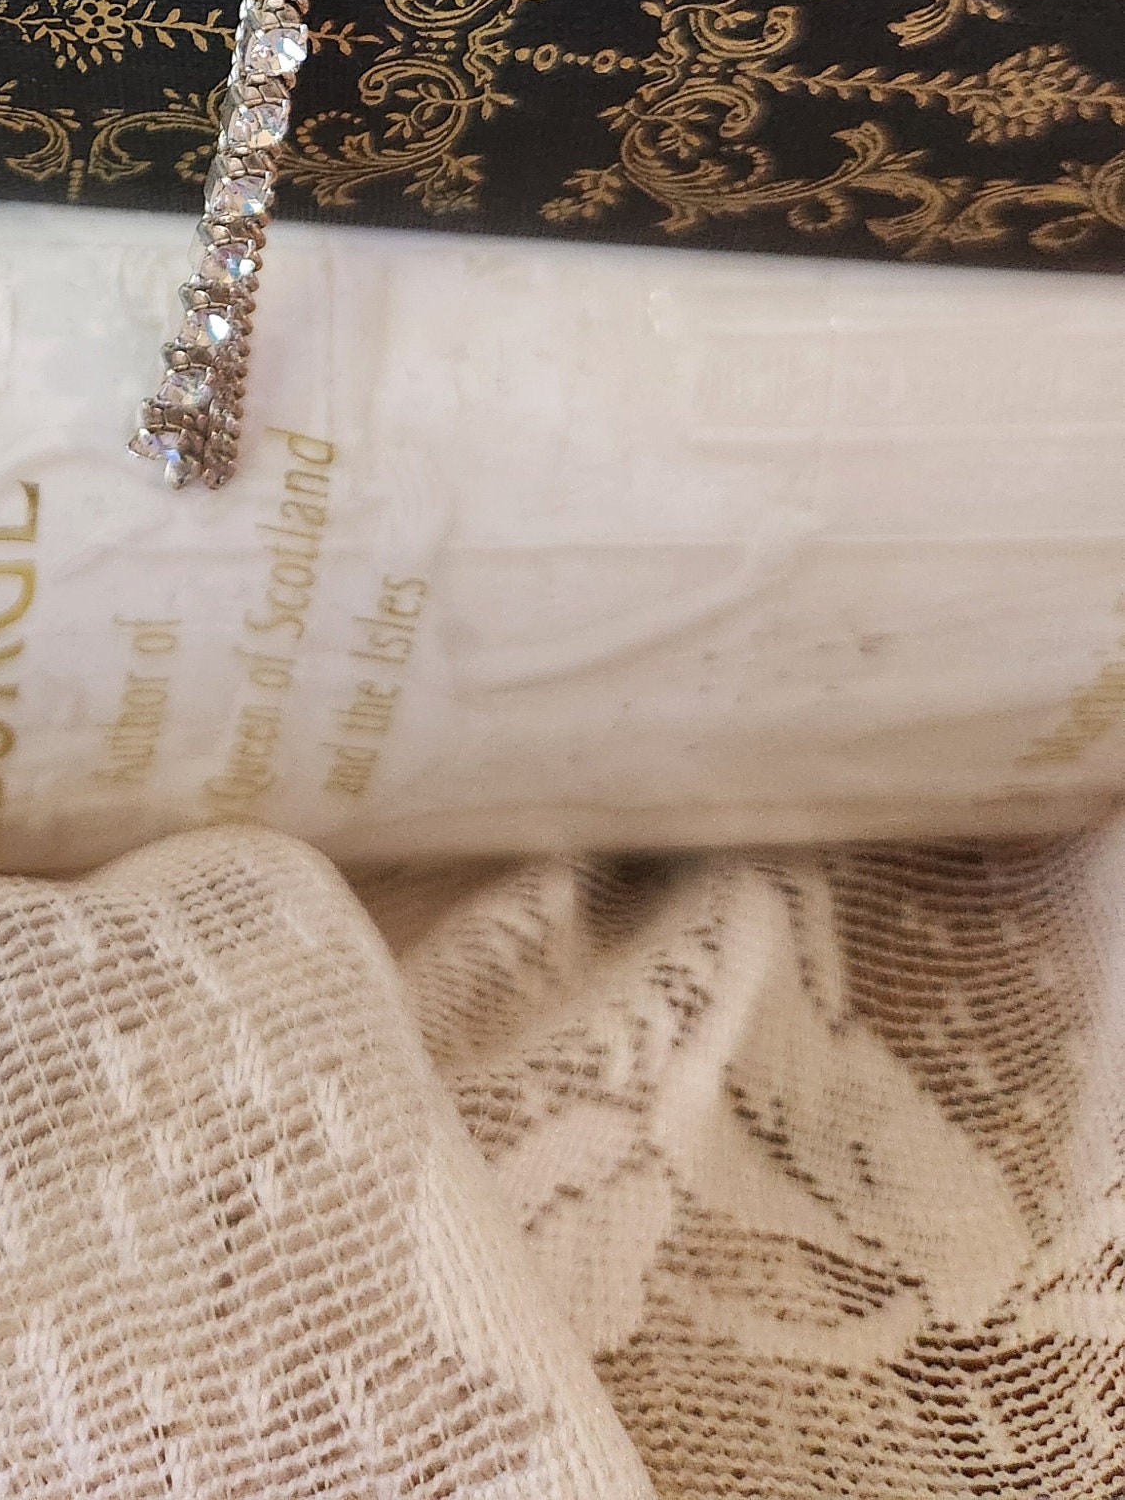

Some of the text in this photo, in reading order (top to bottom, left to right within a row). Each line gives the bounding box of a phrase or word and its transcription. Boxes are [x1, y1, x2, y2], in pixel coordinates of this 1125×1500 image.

[241, 426, 337, 642] Scotland
[91, 613, 181, 789] Author of
[232, 647, 296, 691] of
[320, 573, 428, 798] and the Isles
